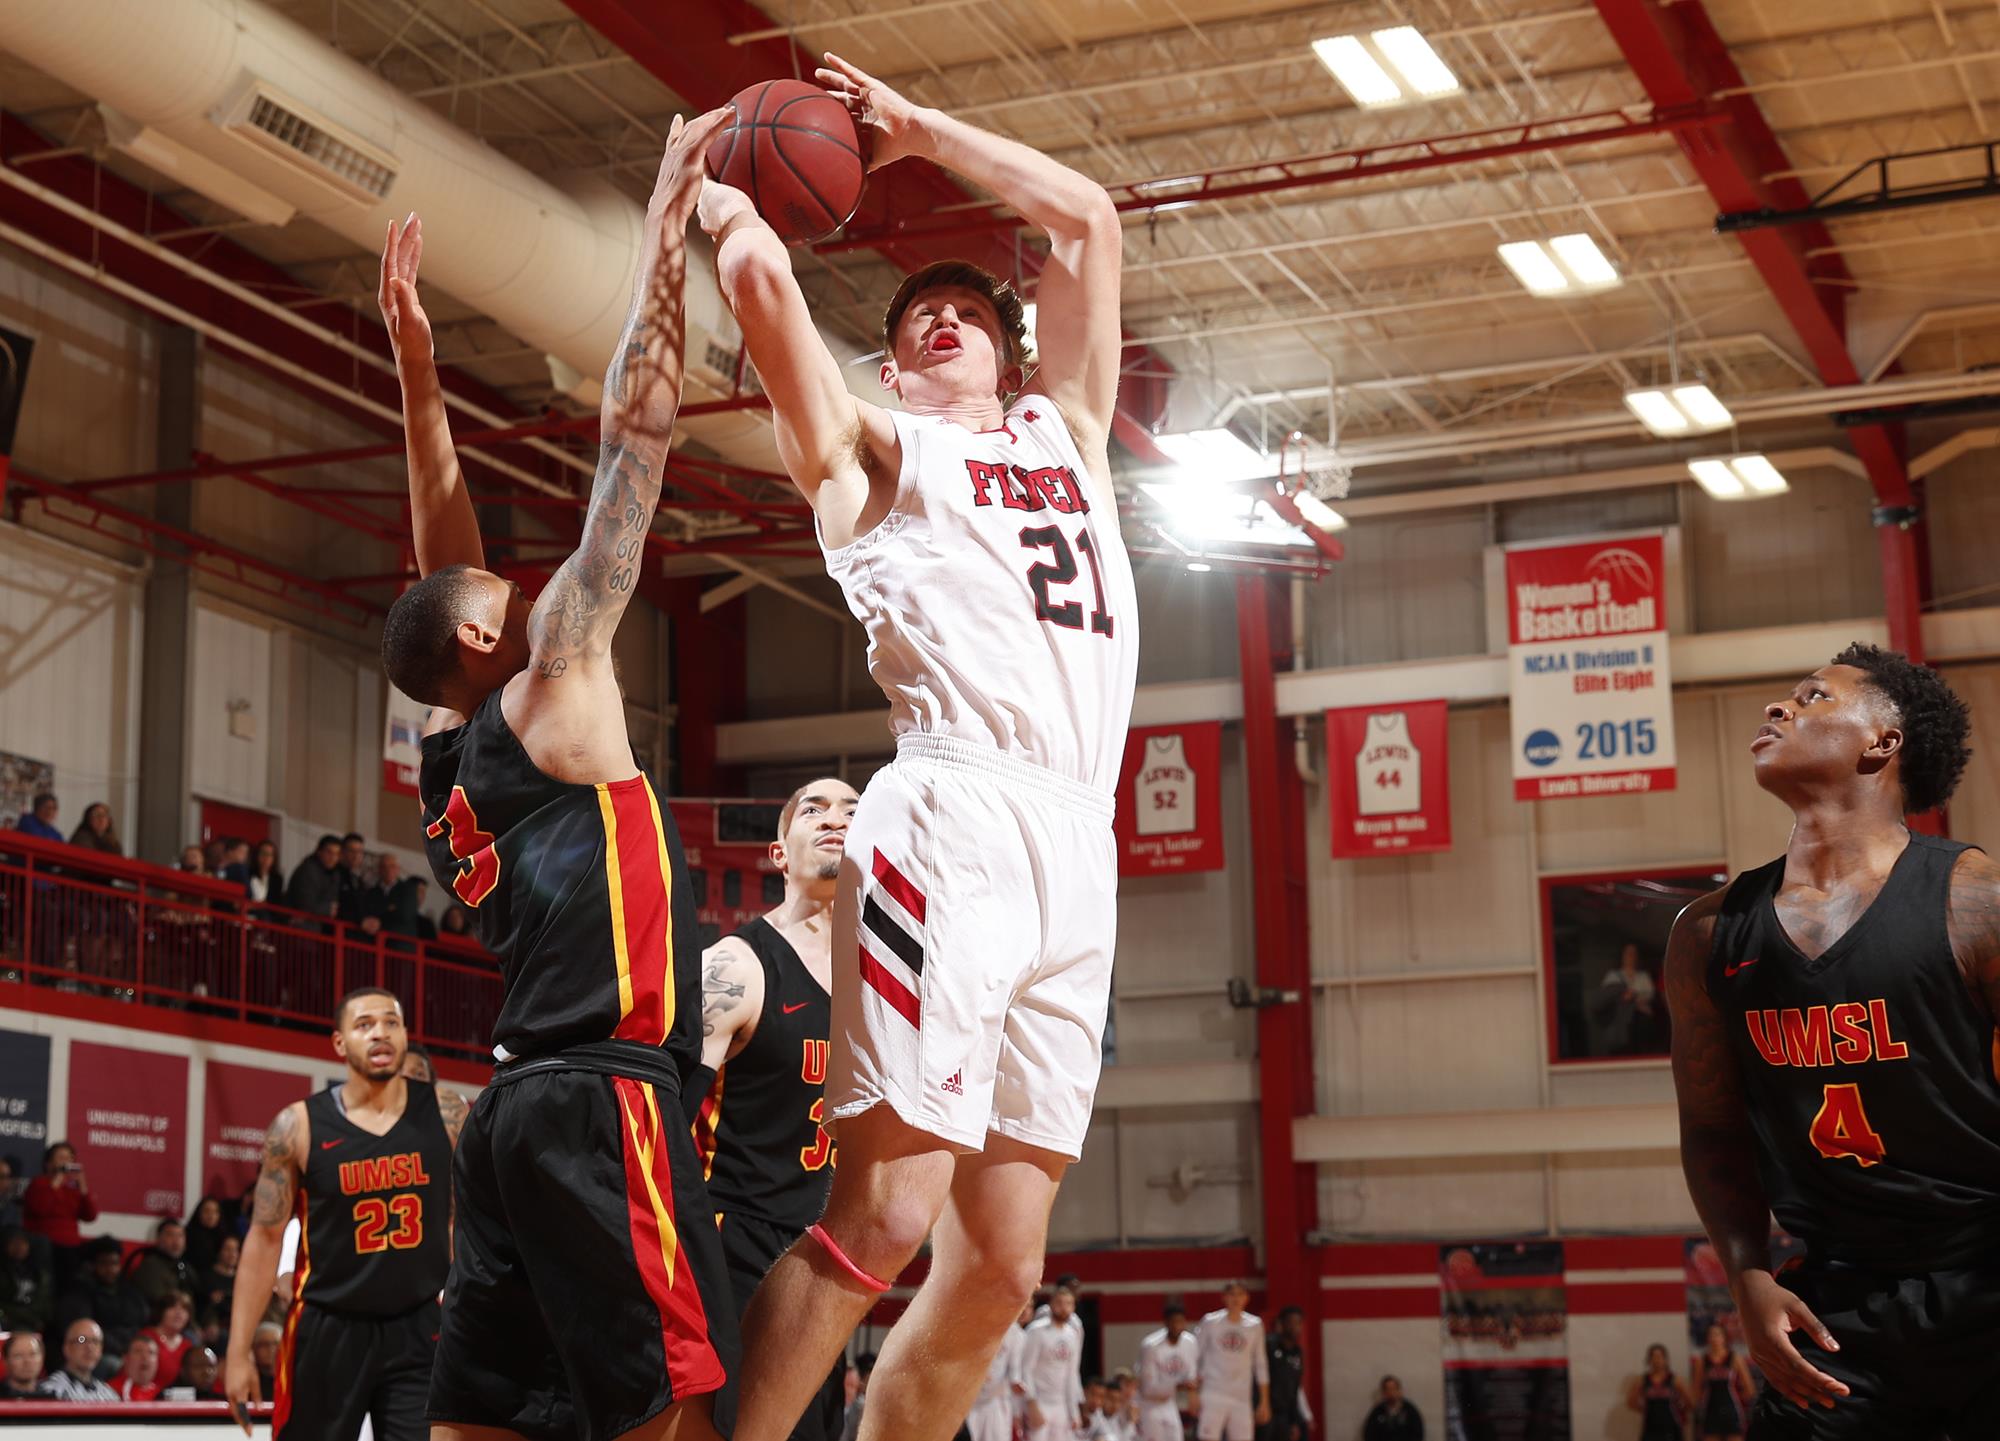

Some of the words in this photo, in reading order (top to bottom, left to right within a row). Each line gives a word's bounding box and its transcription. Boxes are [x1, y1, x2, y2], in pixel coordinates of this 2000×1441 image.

[625, 505, 645, 533] 90
[1018, 524, 1114, 639] 21
[1516, 578, 1611, 608] Women's
[1518, 598, 1656, 641] Basketball
[1524, 654, 1568, 674] NCAA
[1574, 648, 1638, 670] Division
[1574, 674, 1608, 694] Elite
[1614, 669, 1654, 692] Eight
[1576, 719, 1656, 760] 2015
[1366, 744, 1410, 764] LEWIS
[1144, 766, 1186, 785] LEWIS
[1375, 768, 1402, 790] 44
[1539, 777, 1579, 797] Lewis
[1582, 771, 1651, 794] University
[1154, 789, 1178, 810] 52
[427, 785, 500, 908] 3
[1745, 998, 1909, 1068] UMSL
[87, 1109, 150, 1131] UNIVERSITY
[151, 1116, 168, 1133] OF
[1809, 1082, 1887, 1168] 4
[88, 1130, 166, 1153] INDIANAPOLIS
[338, 1151, 430, 1196] UMSL
[353, 1193, 424, 1254] 23
